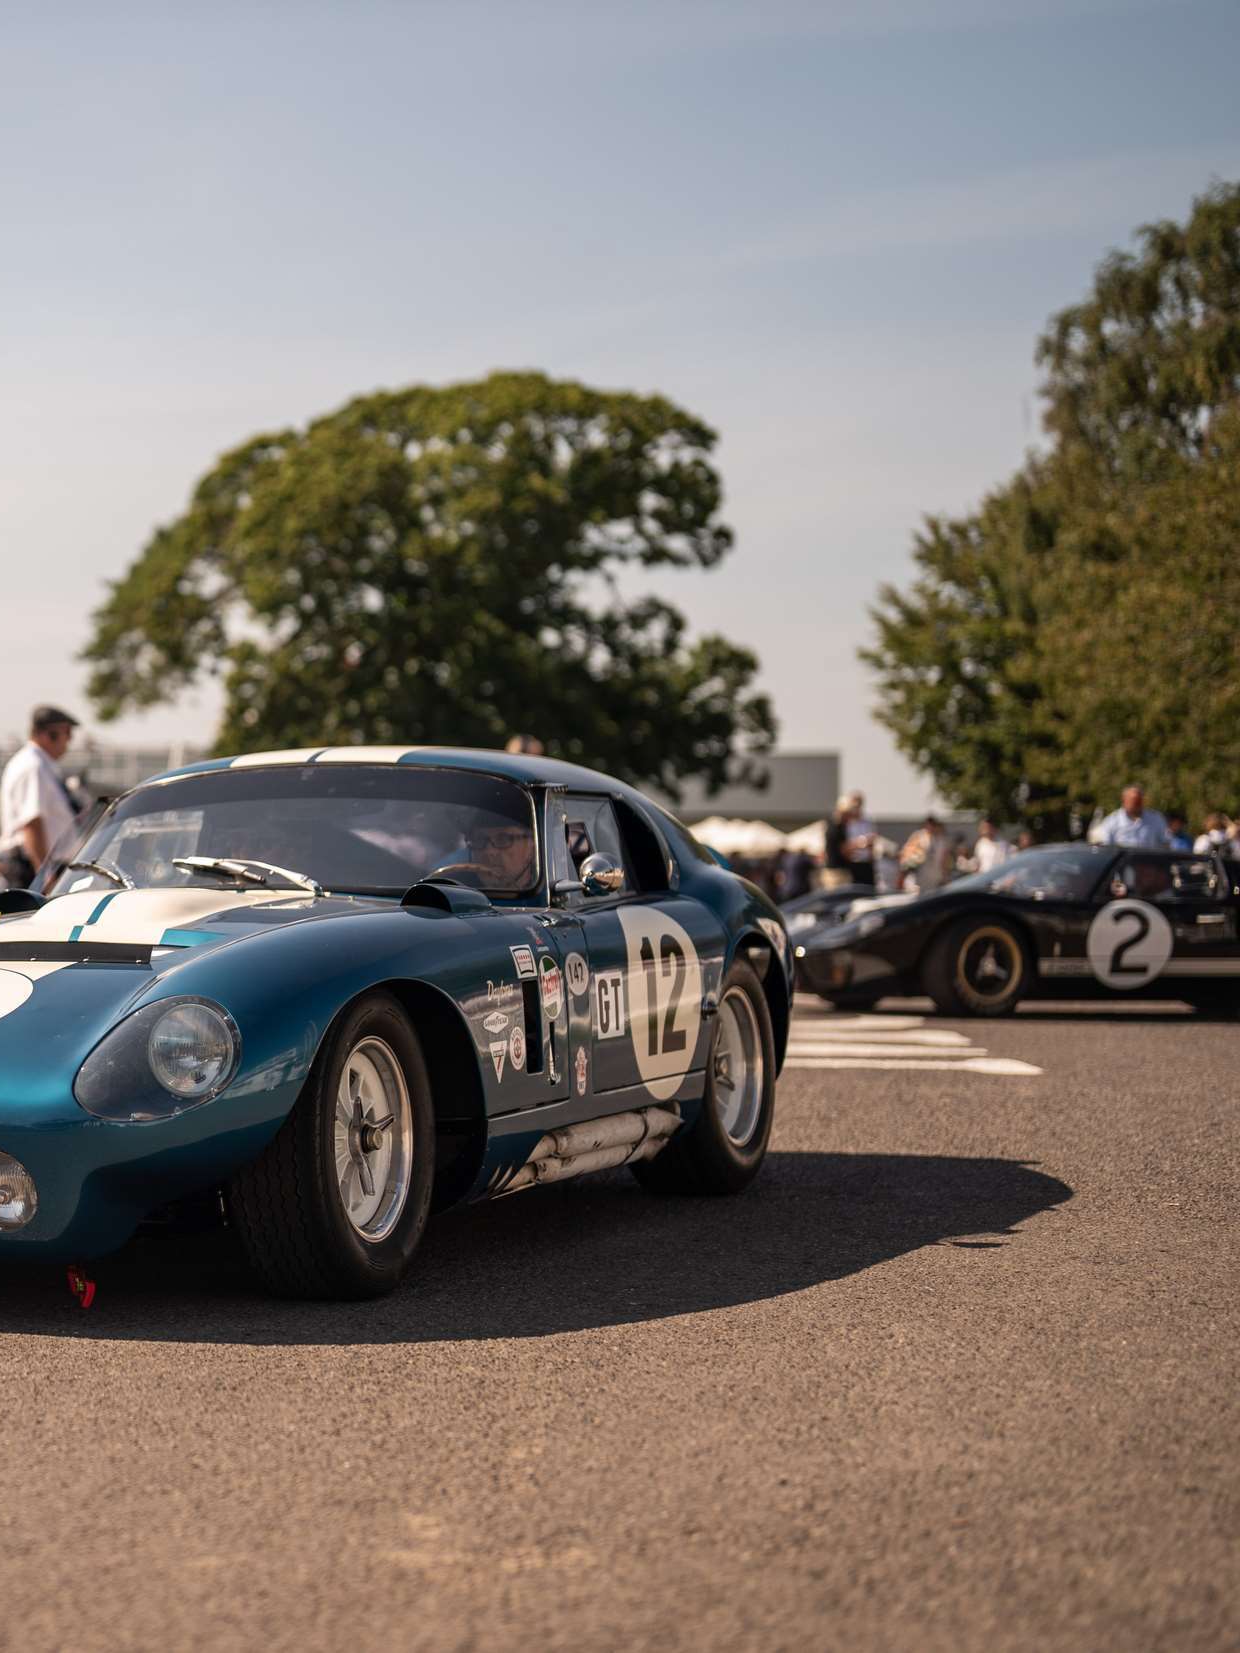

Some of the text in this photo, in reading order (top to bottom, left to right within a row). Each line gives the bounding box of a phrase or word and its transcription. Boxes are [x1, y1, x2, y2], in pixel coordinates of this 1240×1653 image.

[1110, 907, 1150, 974] 2
[598, 978, 621, 1034] GT
[640, 934, 687, 1057] 12
